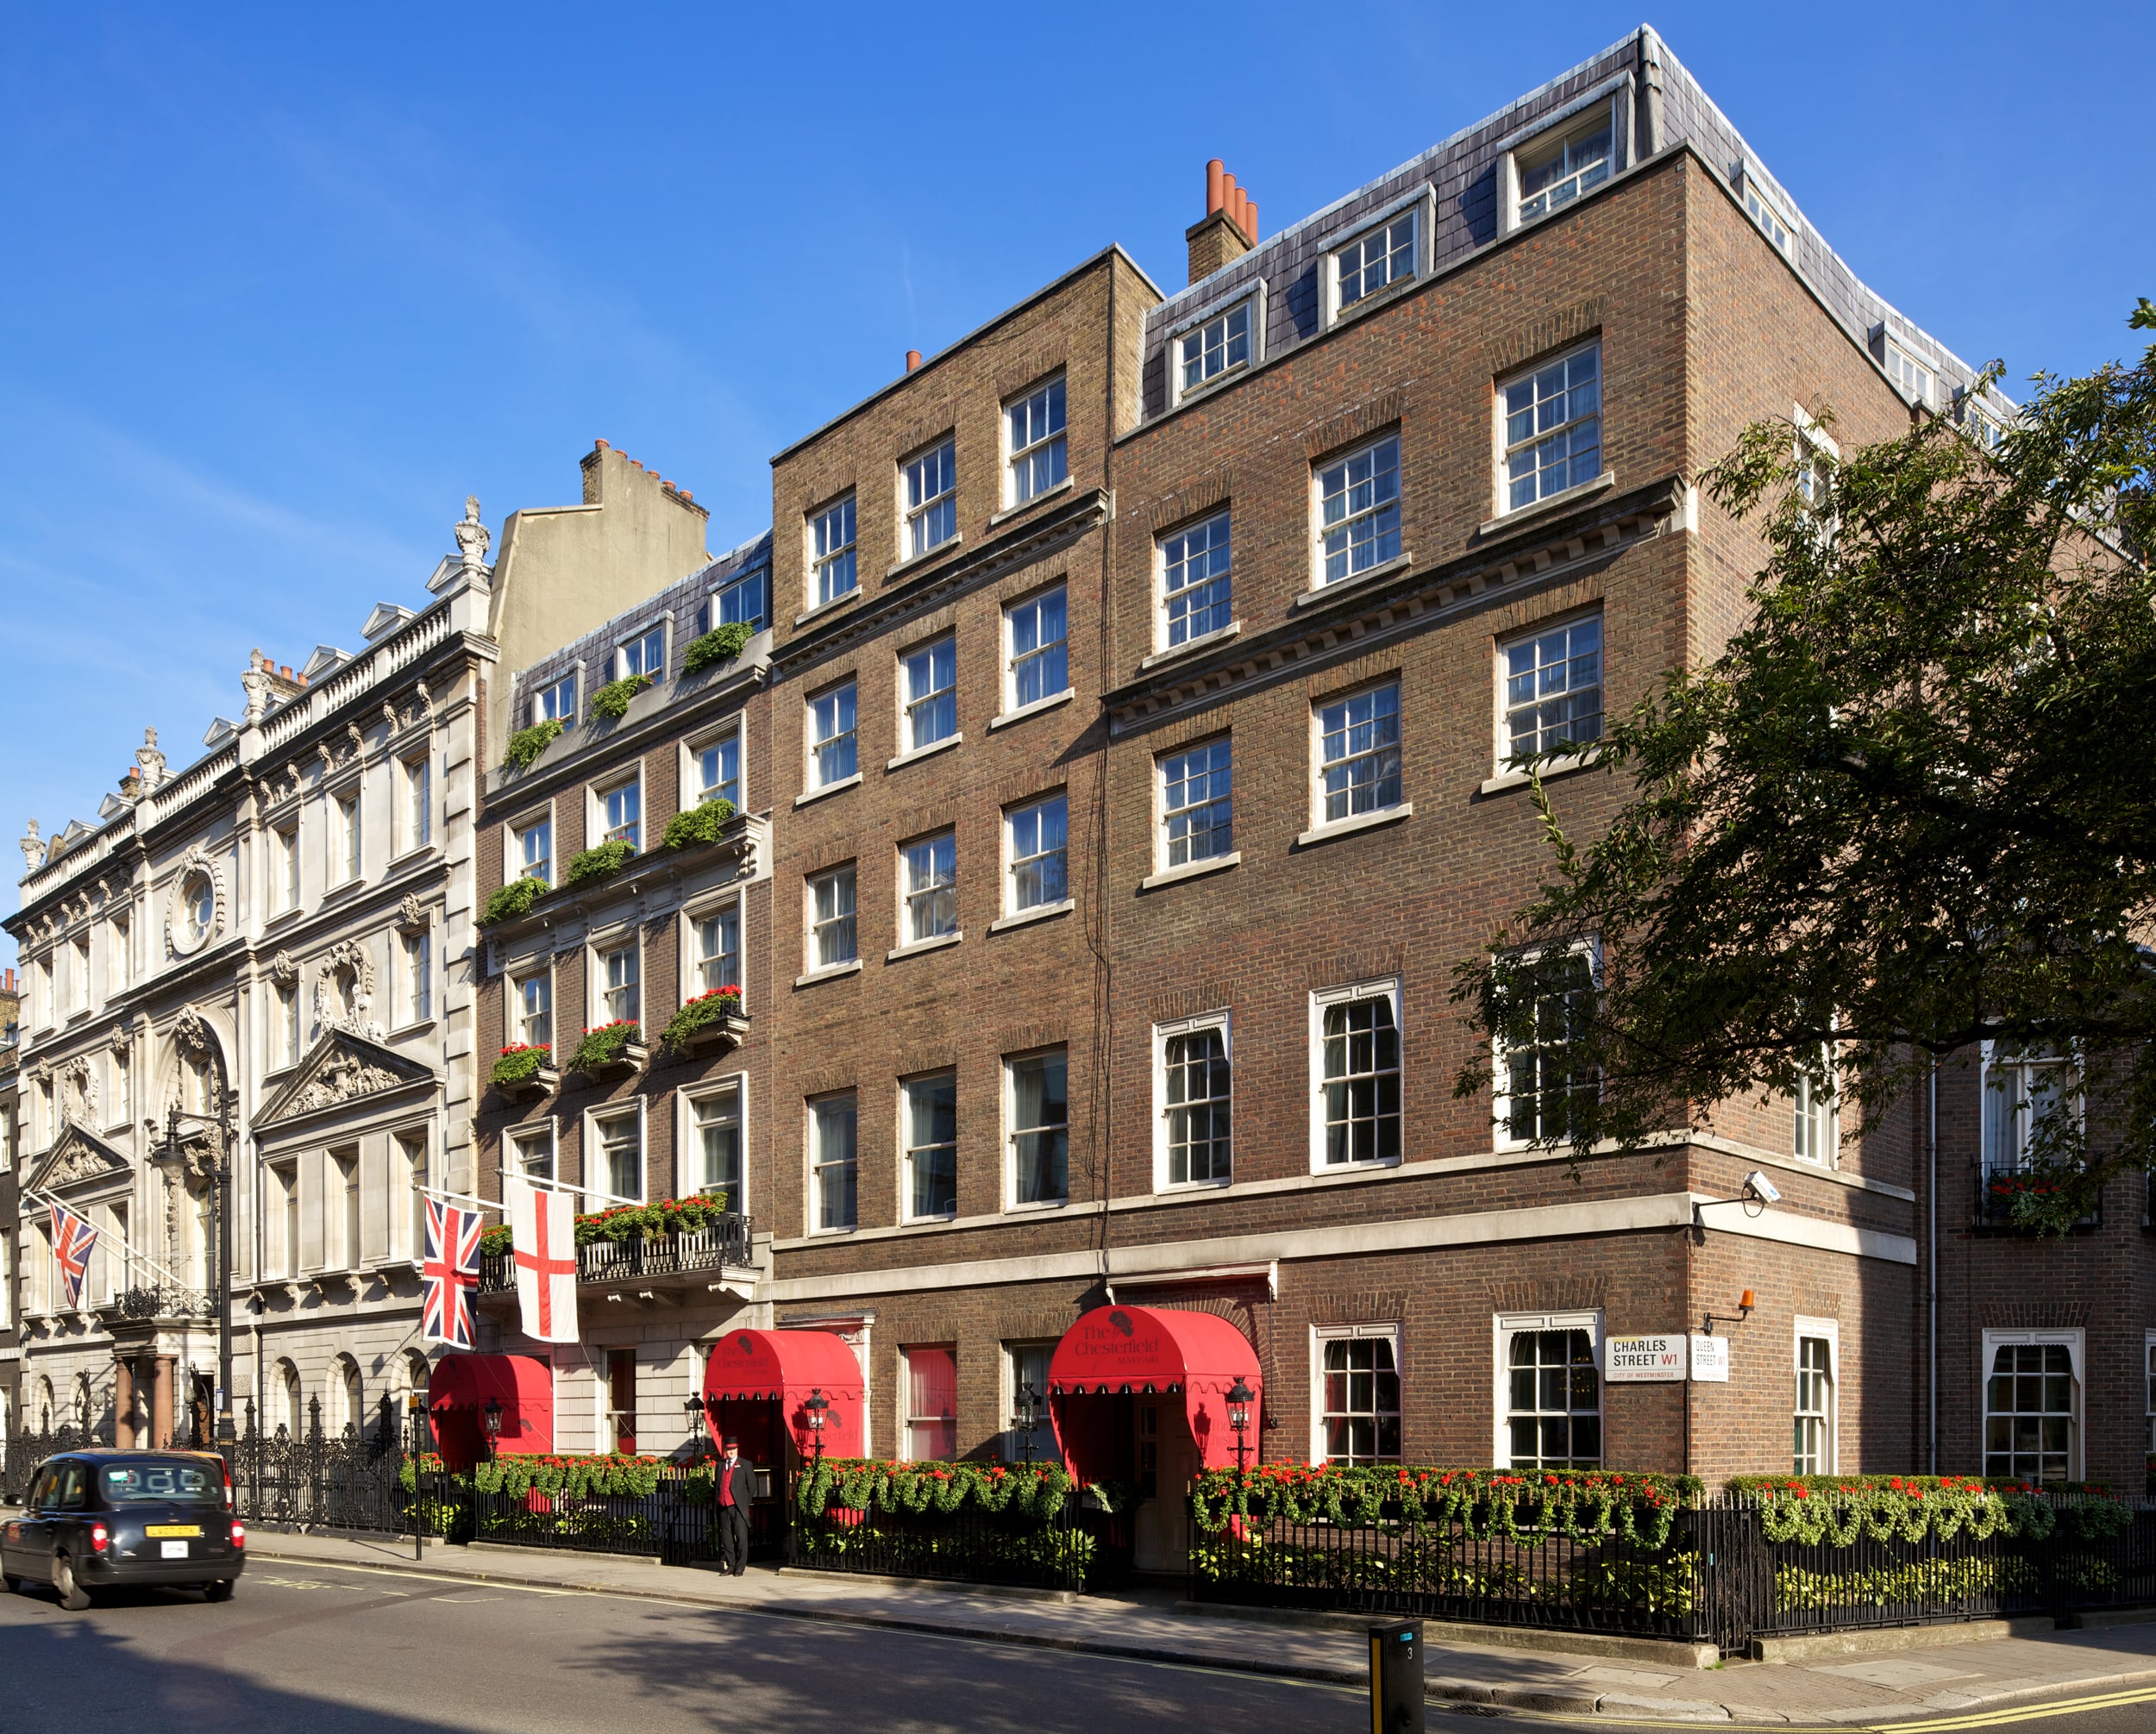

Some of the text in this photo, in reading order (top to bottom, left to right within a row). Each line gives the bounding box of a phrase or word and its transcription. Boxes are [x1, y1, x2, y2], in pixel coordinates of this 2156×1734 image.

[1081, 1324, 1111, 1340] The
[1075, 1337, 1159, 1356] Chesterfield
[1614, 1339, 1666, 1353] CHARLES
[1695, 1340, 1714, 1352] QUEEN
[1614, 1354, 1677, 1367] STREET W1
[1695, 1354, 1716, 1366] STREET
[1407, 1647, 1413, 1661] 3
